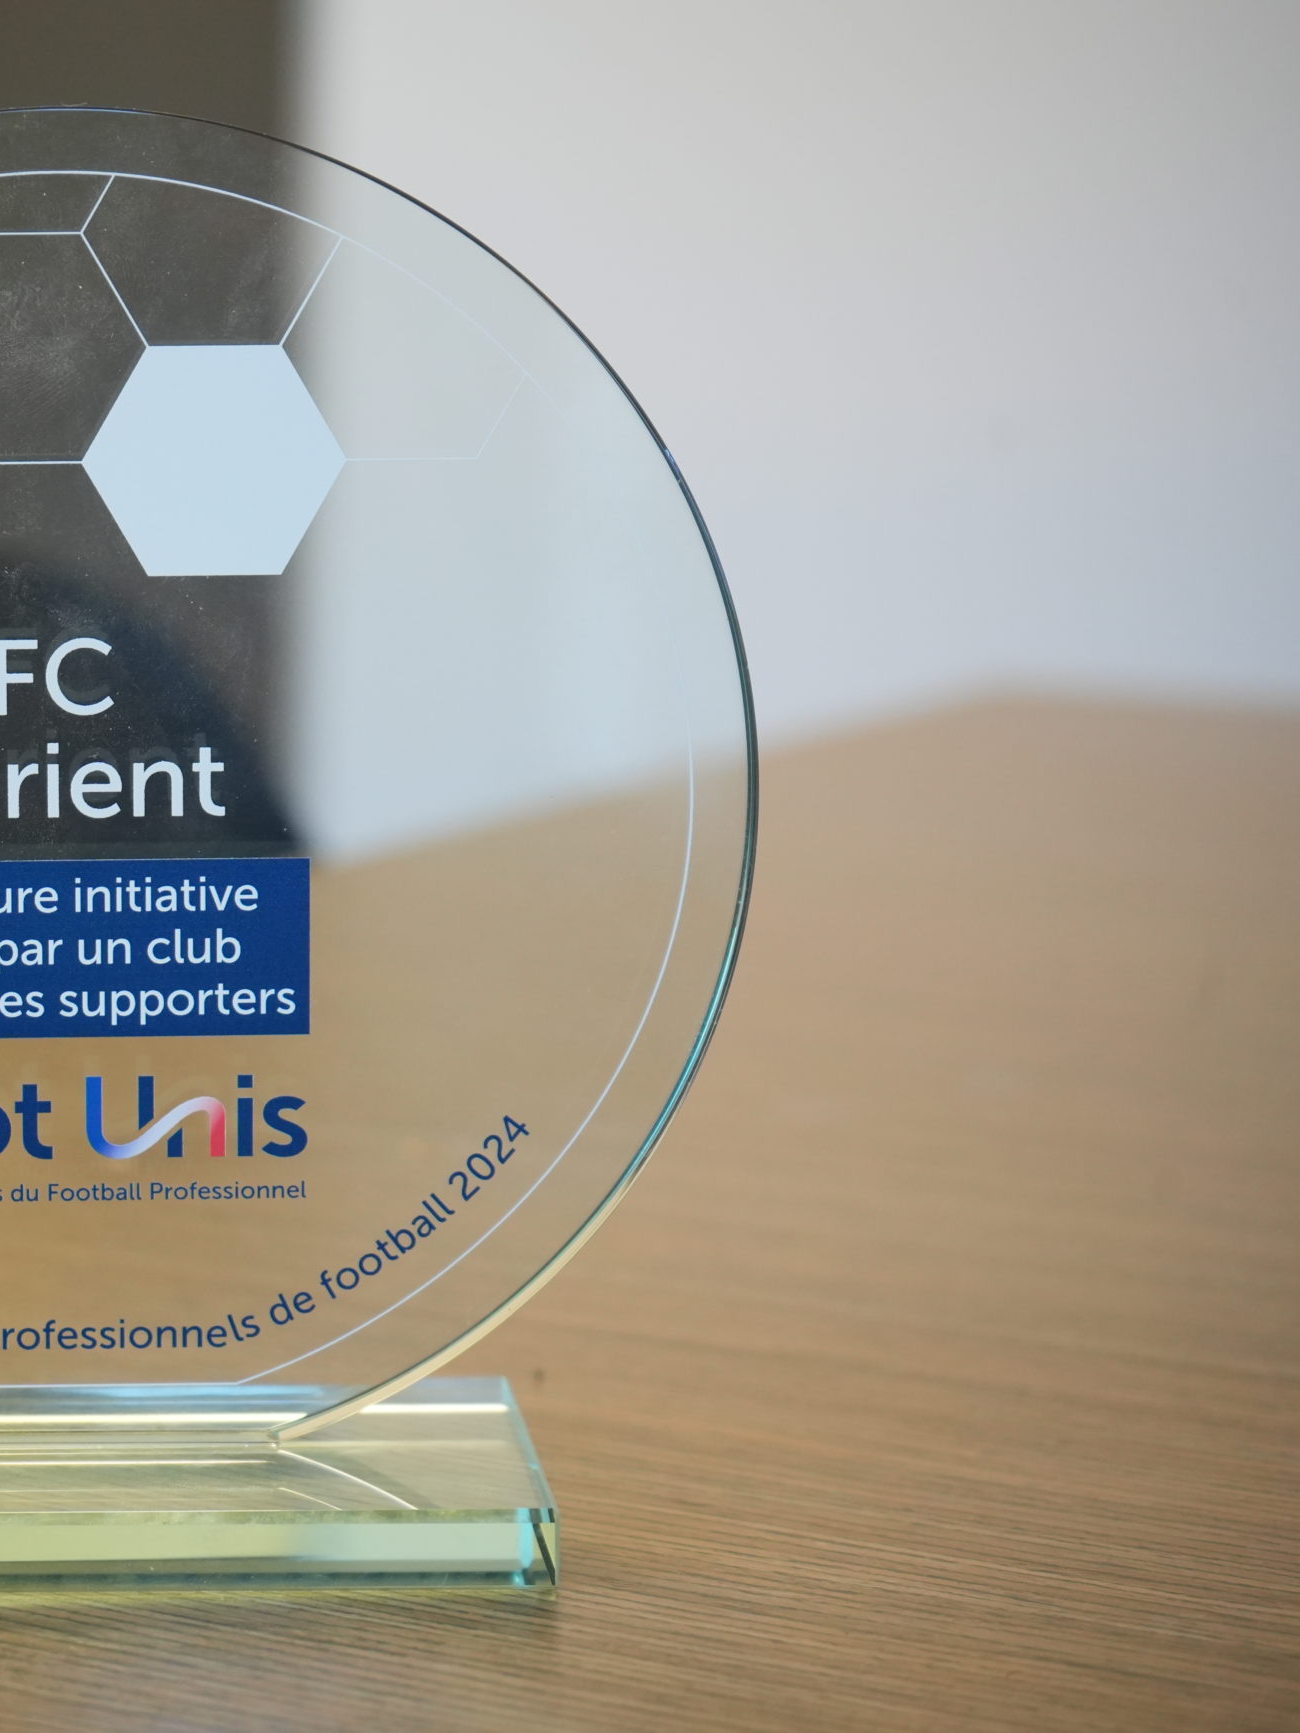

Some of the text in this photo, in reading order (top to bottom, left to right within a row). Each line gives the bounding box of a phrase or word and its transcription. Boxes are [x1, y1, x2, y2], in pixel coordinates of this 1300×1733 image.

[73, 876, 259, 914] initiative
[77, 935, 132, 966] un
[146, 928, 242, 965] club
[57, 983, 297, 1026] supporters
[85, 1073, 309, 1161] Unis
[10, 1182, 40, 1202] du
[47, 1181, 142, 1203] Football
[149, 1180, 307, 1201] Professionnel
[268, 1292, 317, 1326] de
[319, 1192, 456, 1301] football
[448, 1114, 531, 1203] 2024
